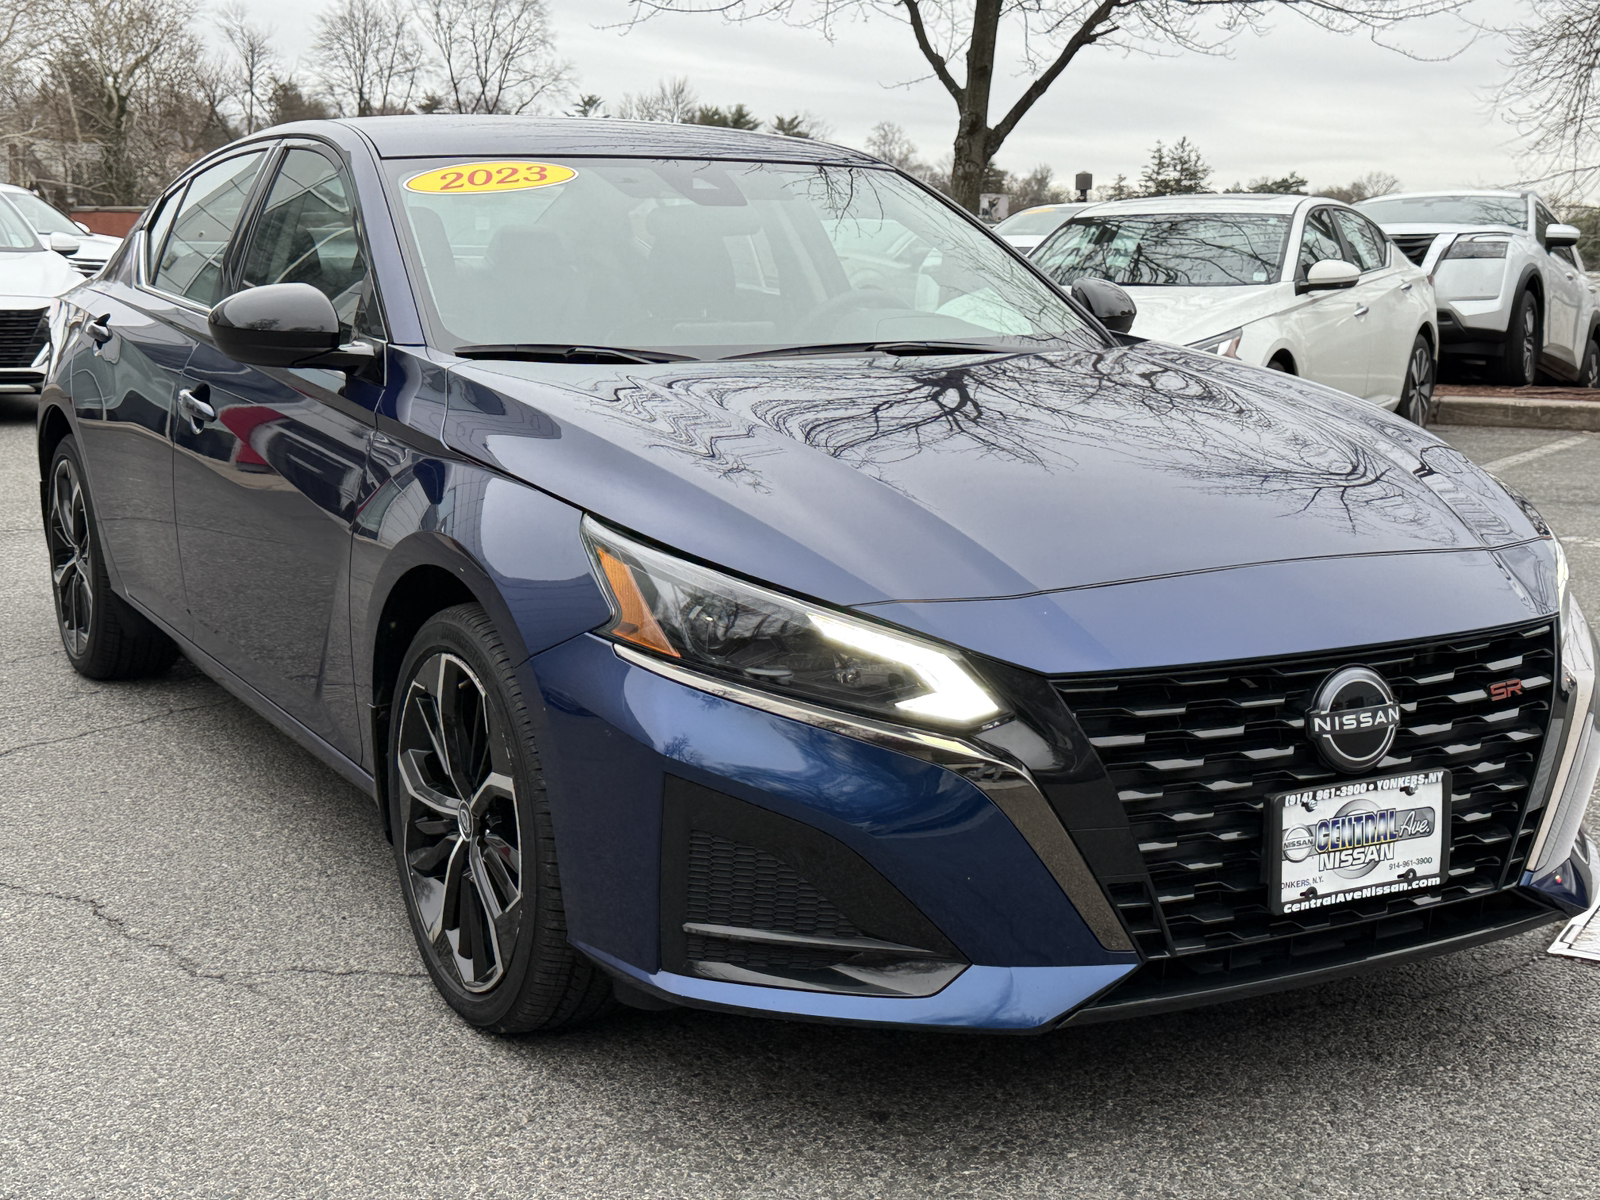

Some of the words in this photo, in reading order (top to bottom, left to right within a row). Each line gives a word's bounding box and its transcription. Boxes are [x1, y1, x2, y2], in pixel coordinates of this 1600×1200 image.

[440, 166, 547, 190] 2023
[1490, 679, 1522, 701] SR
[1314, 706, 1399, 731] NISSAN
[1315, 808, 1398, 853] CENTRAL
[1400, 811, 1430, 836] Ave.
[1283, 838, 1314, 849] NISSAN
[1318, 842, 1394, 872] NISSAN
[1388, 857, 1433, 871] 914-961-3900
